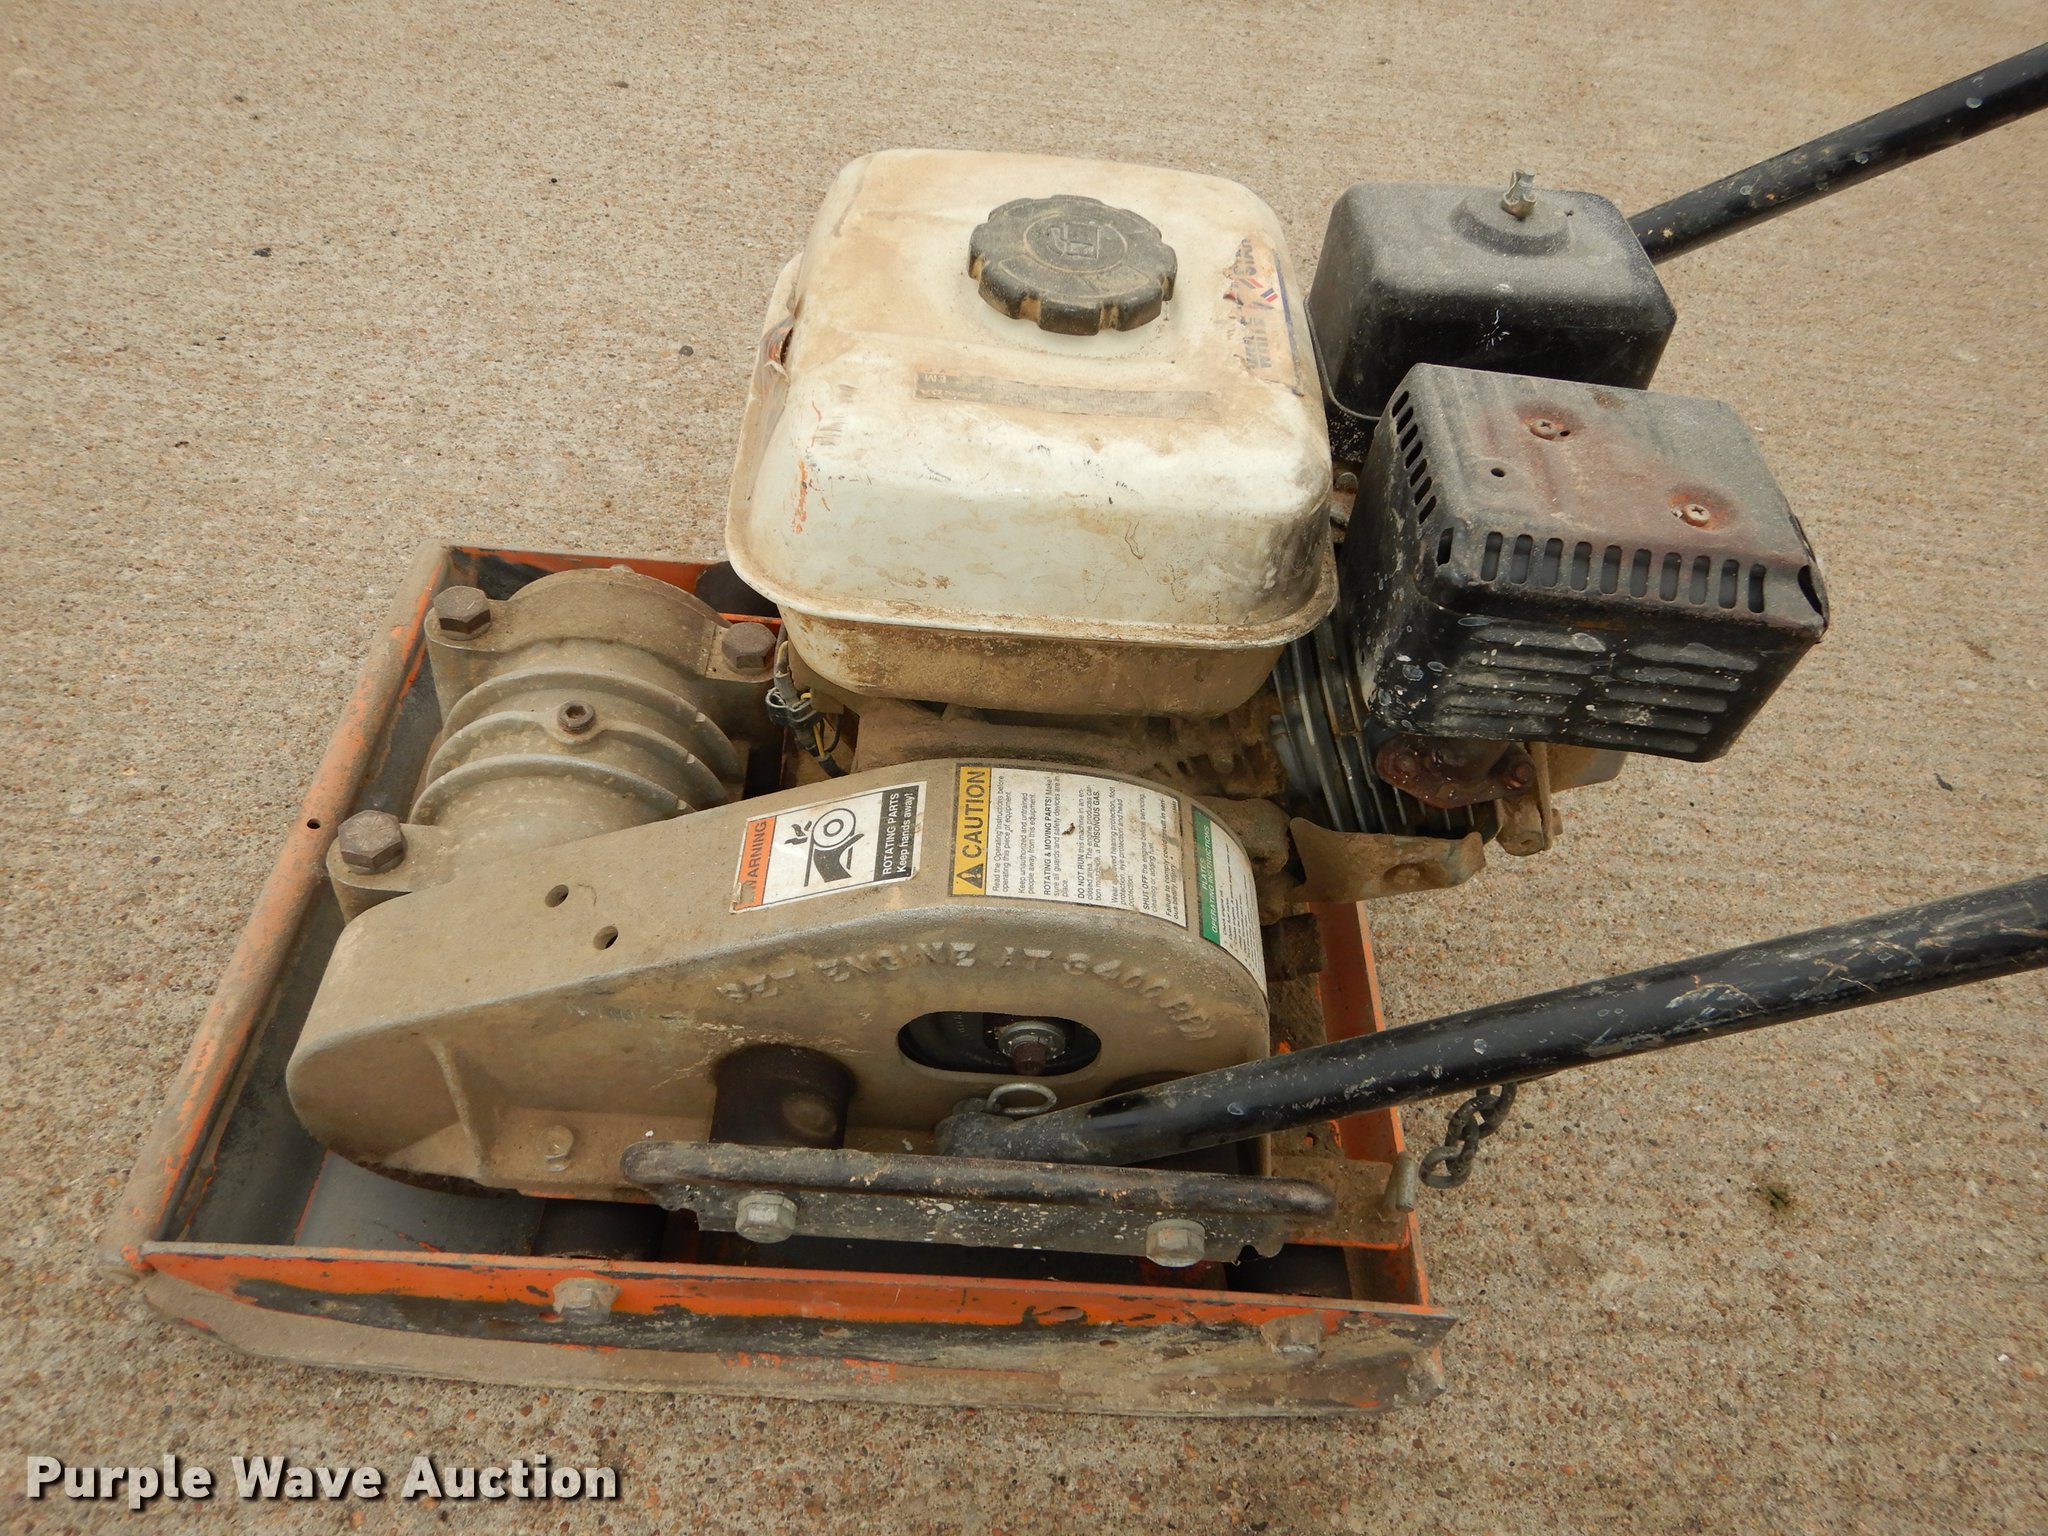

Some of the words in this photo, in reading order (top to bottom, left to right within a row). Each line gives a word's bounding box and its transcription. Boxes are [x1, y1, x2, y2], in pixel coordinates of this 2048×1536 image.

[888, 793, 900, 824] PARTS
[900, 792, 914, 818] away!
[962, 771, 985, 858] CAUTION
[995, 795, 1003, 830] Instructions
[1020, 793, 1028, 820] untrained
[898, 820, 911, 847] hands
[1093, 807, 1101, 848] POISONOUS
[882, 825, 896, 875] ROTATING
[994, 831, 1003, 861] Operating
[1019, 835, 1027, 875] unauthorized
[1140, 842, 1148, 862] engine
[1203, 824, 1214, 884] INSTRUCTIONS
[896, 849, 909, 872] Keep
[1053, 850, 1061, 872] guards
[992, 874, 1000, 891] Read
[1002, 863, 1010, 892] operating
[1019, 877, 1027, 893] Keep
[1027, 872, 1035, 894] people
[1078, 888, 1085, 899] DO
[1164, 893, 1172, 916] Failure
[1208, 885, 1218, 933] OPERATING
